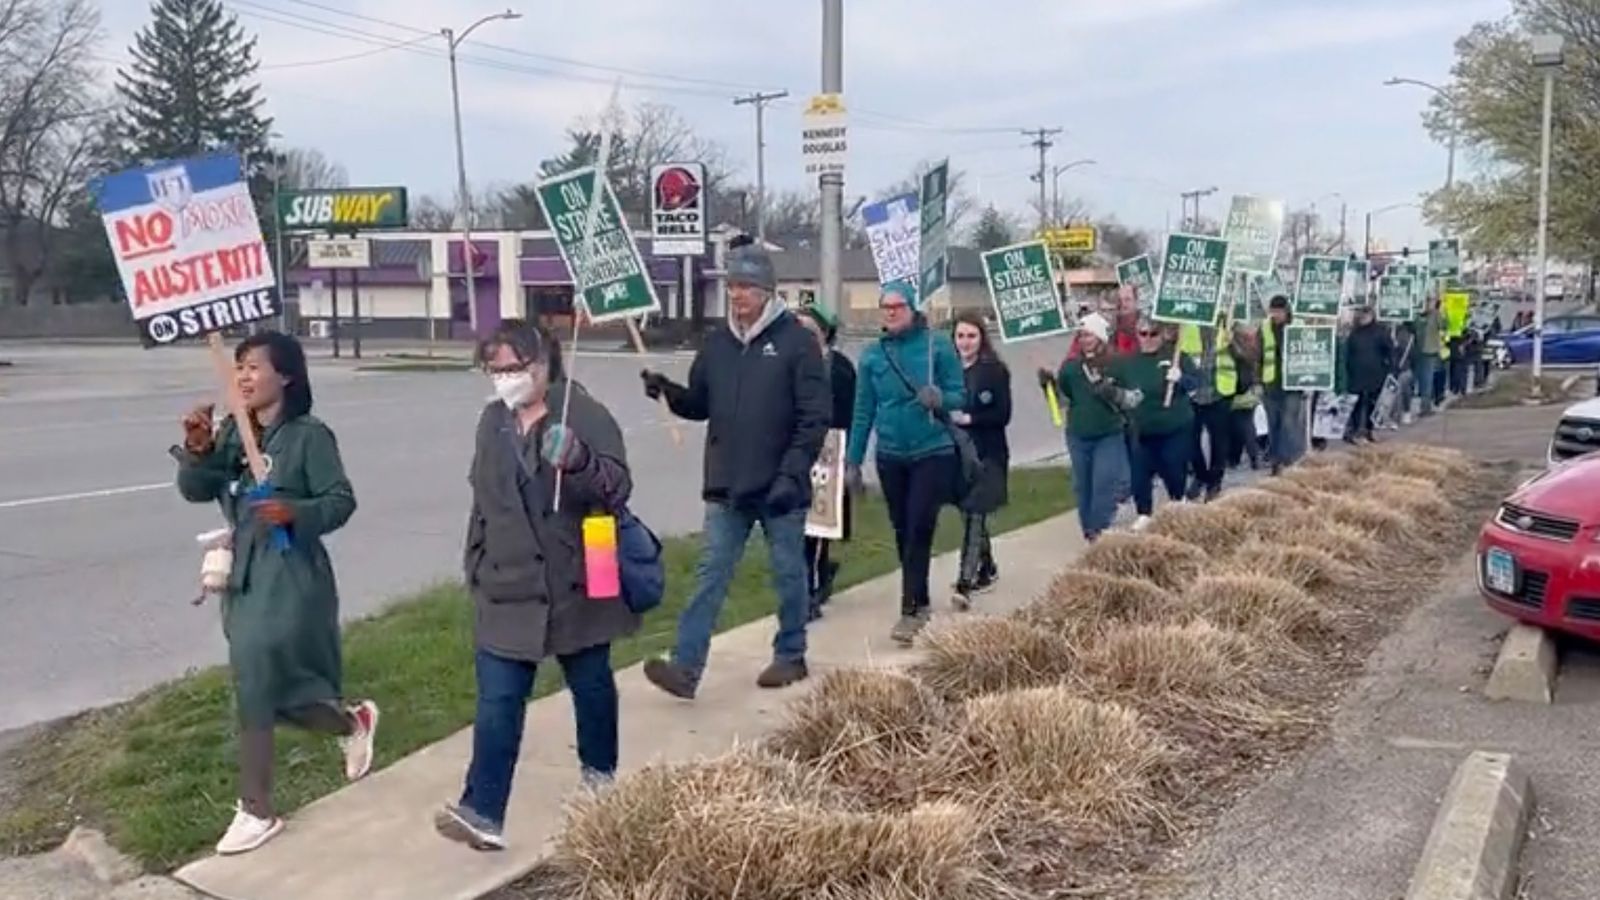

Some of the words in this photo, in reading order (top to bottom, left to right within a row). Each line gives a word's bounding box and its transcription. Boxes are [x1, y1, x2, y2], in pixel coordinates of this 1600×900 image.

[803, 127, 846, 139] KENNEDY
[803, 141, 847, 154] DOUGLAS
[559, 179, 588, 211] ON
[285, 192, 392, 225] SUBWAY
[655, 212, 699, 223] TACO
[115, 209, 173, 252] NO
[657, 224, 699, 234] BELL
[1187, 240, 1207, 256] ON
[1004, 250, 1025, 269] ON
[1168, 254, 1218, 274] STRIKE
[994, 264, 1045, 290] STRIKE
[153, 318, 175, 339] ON
[180, 291, 274, 334] STRIKE
